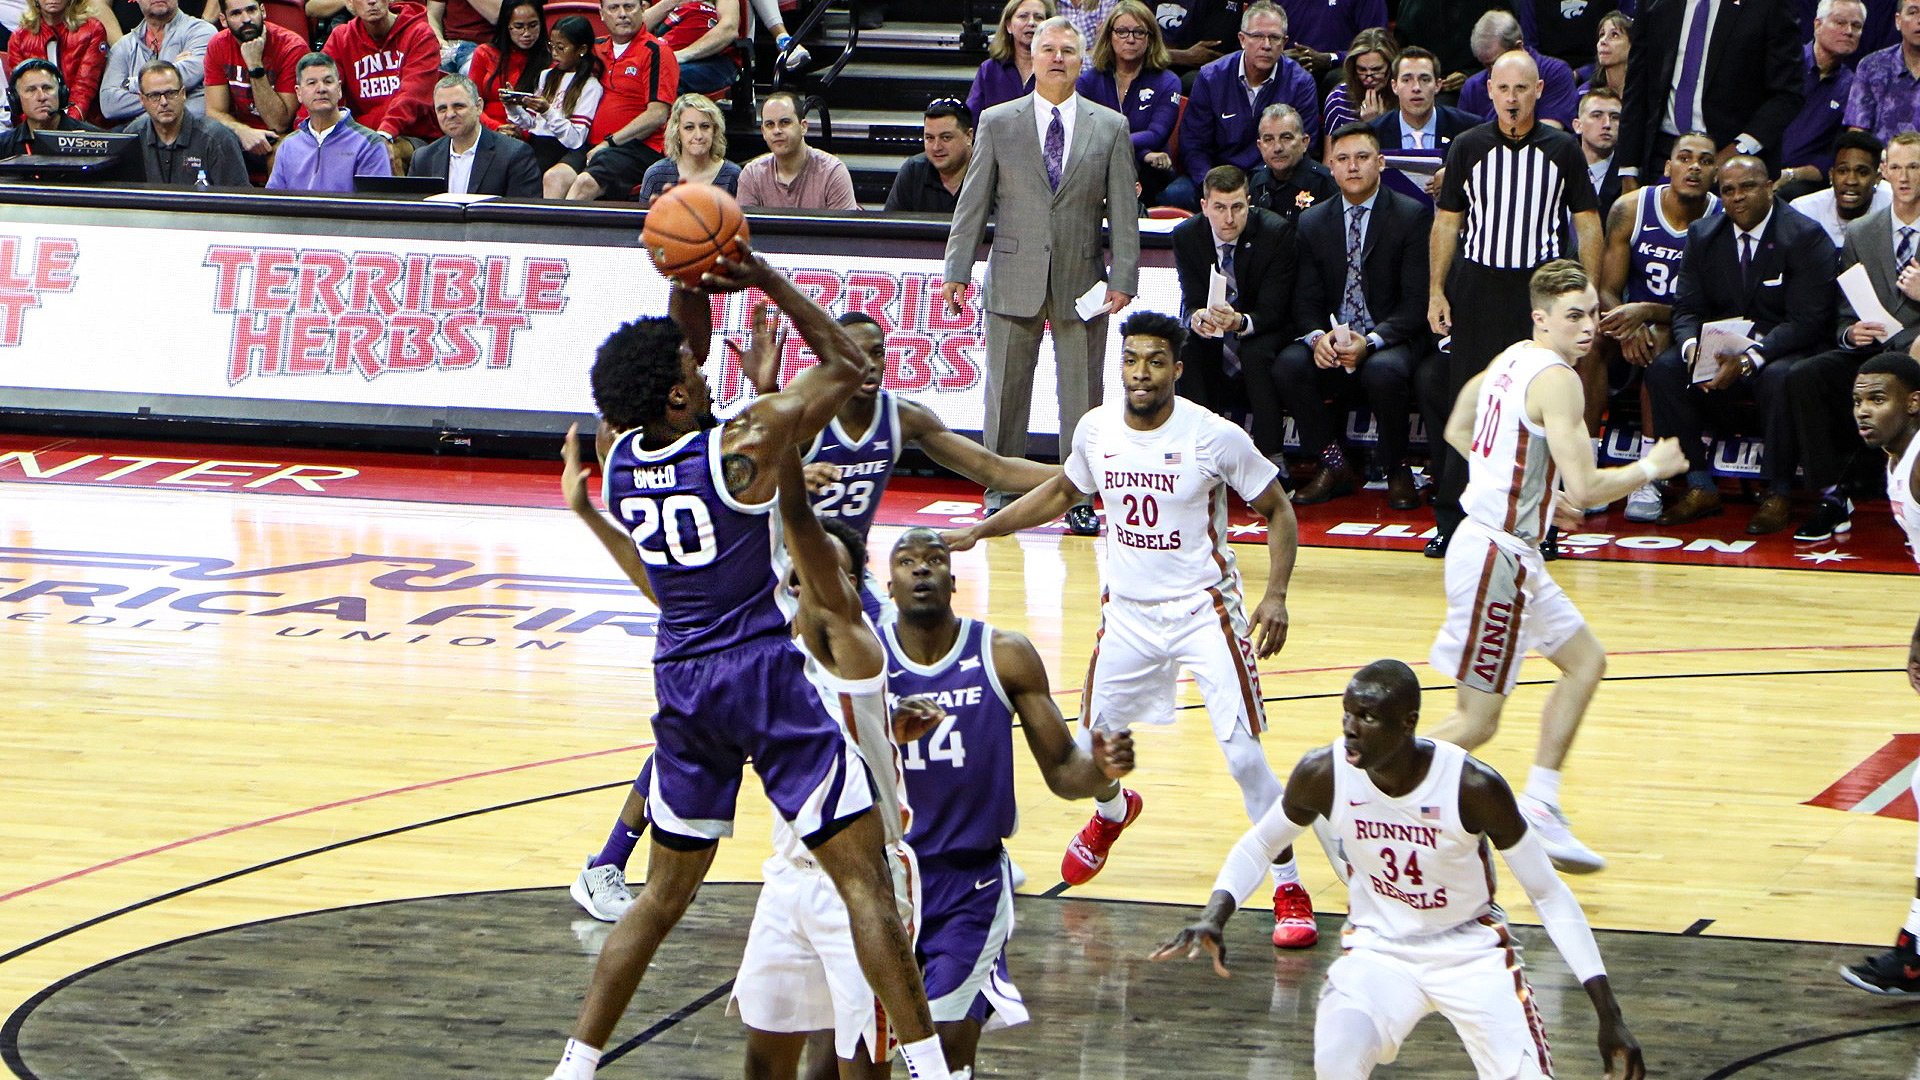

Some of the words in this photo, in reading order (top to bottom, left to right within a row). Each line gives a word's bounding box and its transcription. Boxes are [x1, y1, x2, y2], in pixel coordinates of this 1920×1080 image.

[201, 244, 570, 316] TERRIBLE
[227, 312, 533, 388] HERBST
[812, 480, 875, 517] 23
[1104, 471, 1180, 494] RUNNIN'
[1122, 494, 1158, 528] 20
[620, 495, 718, 567] 20
[1115, 523, 1181, 550] REBELS
[0, 577, 367, 622] RICA
[275, 626, 567, 651] UNION
[1473, 601, 1512, 684] UNLV
[904, 715, 966, 771] 14
[1354, 819, 1443, 850] RUNNIN'
[1380, 847, 1424, 886] 34
[1369, 873, 1449, 911] REBELS
